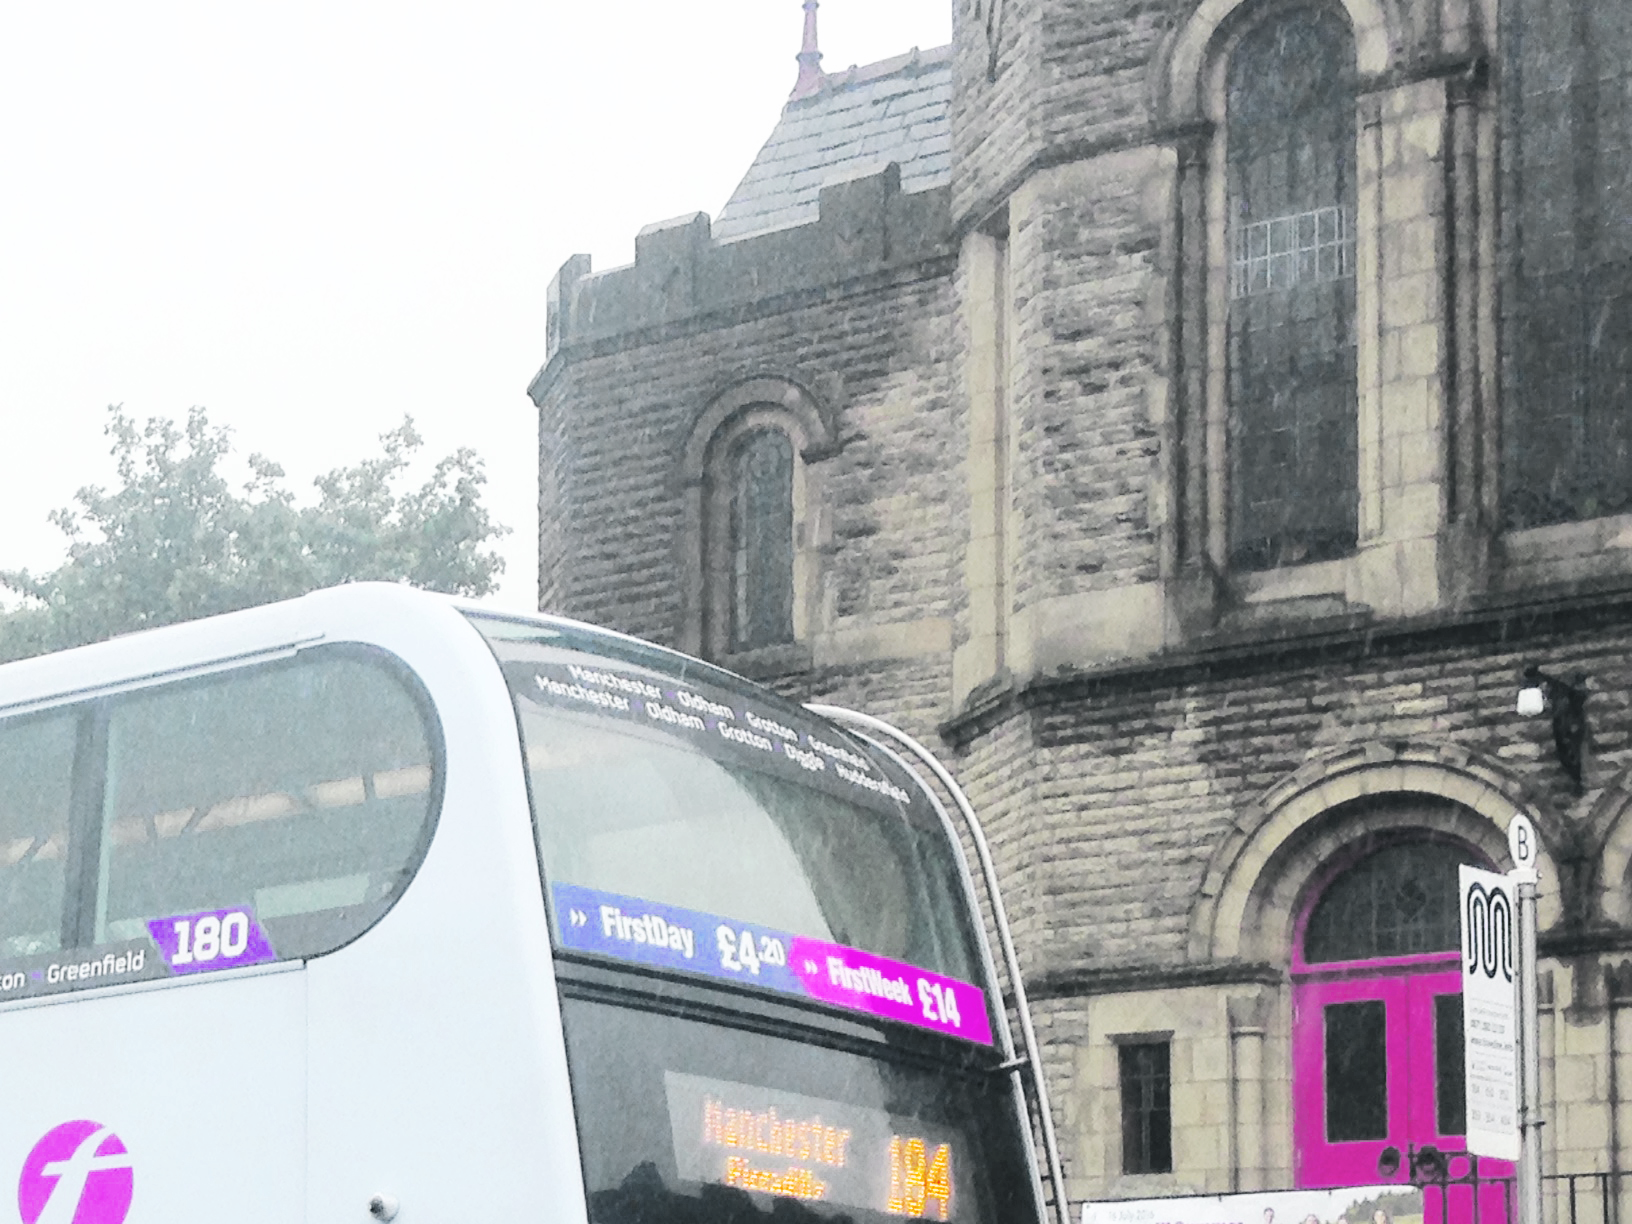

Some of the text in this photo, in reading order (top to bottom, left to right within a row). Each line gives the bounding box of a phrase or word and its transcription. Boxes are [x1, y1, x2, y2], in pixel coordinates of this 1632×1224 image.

[645, 702, 706, 731] Oldham
[171, 911, 249, 965] 180
[600, 904, 694, 959] FirstDay
[47, 950, 145, 983] Greenfield
[826, 956, 961, 1028] FirstWeek £14
[888, 1135, 950, 1222] 184
